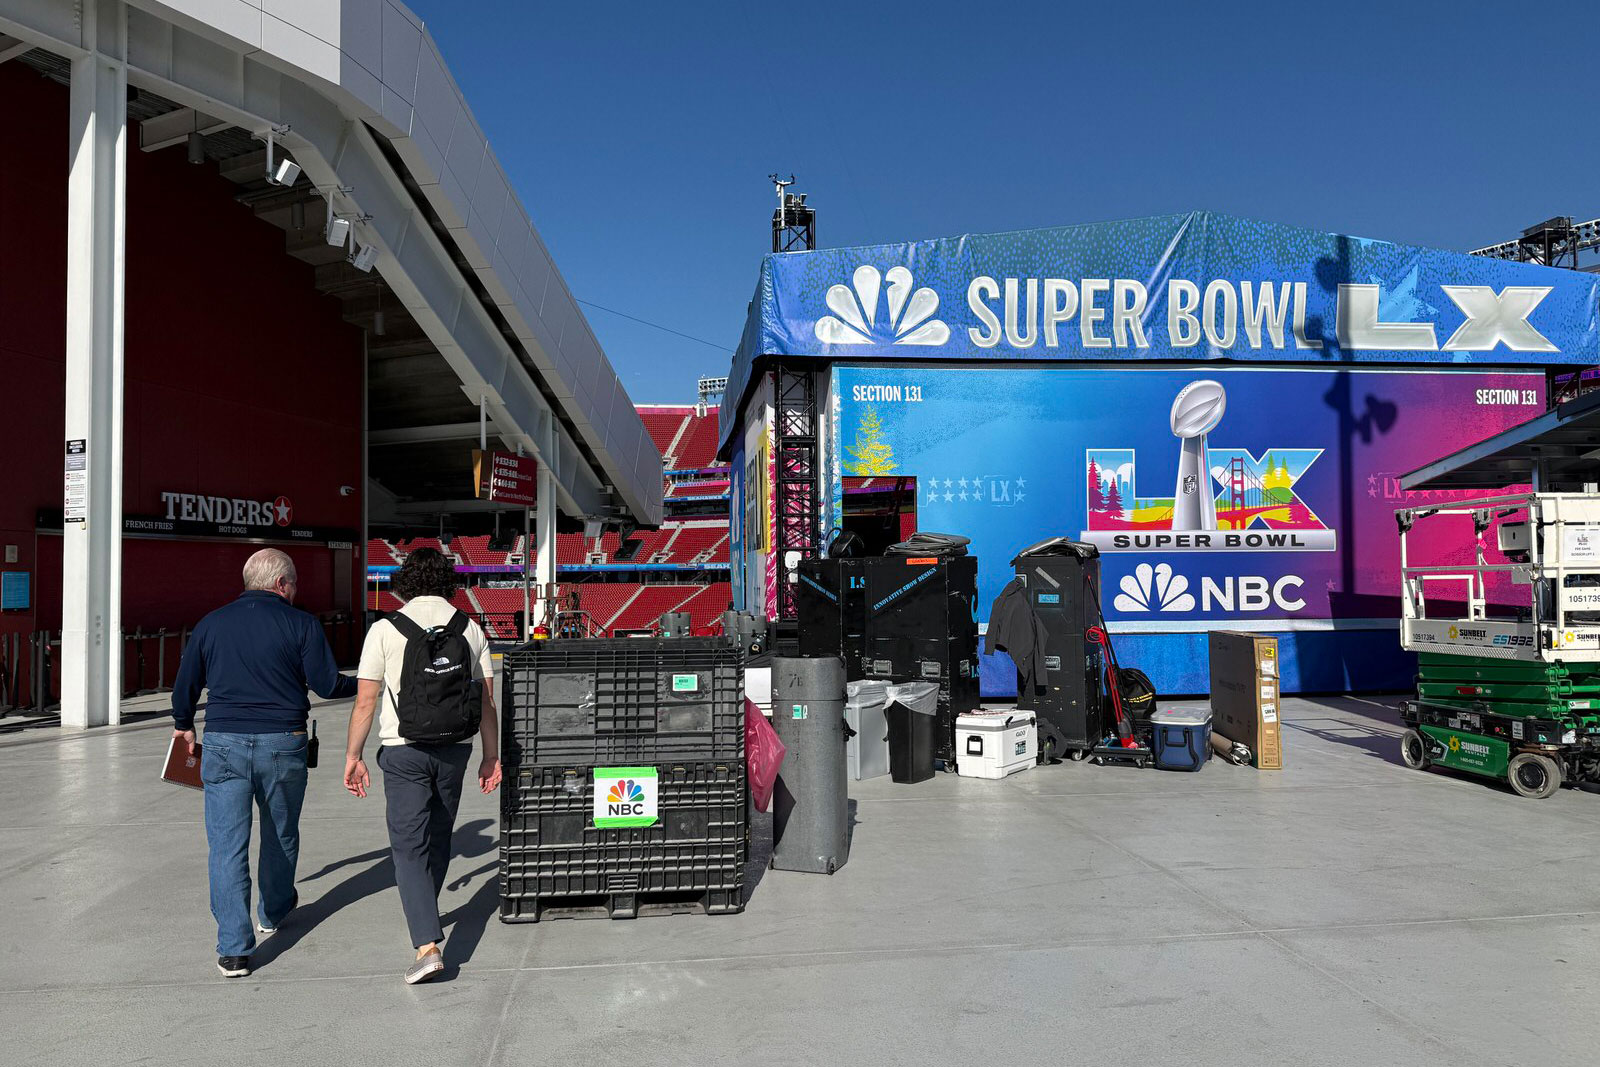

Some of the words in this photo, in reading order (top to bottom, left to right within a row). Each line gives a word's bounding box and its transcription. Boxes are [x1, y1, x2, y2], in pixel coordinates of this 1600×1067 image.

[967, 276, 1149, 349] SUPER
[1168, 279, 1323, 350] BOWL
[1335, 283, 1561, 352] LX
[853, 385, 902, 402] SECTION
[904, 385, 923, 402] 131
[1476, 388, 1519, 405] SECTION
[1521, 389, 1538, 406] 131
[991, 480, 1010, 502] LX
[1086, 448, 1329, 531] LX
[1383, 477, 1402, 499] LX
[161, 491, 274, 526] TENDERS
[125, 520, 154, 530] FRENCH
[154, 522, 174, 530] FRIES
[218, 525, 231, 533] HOT
[231, 526, 248, 534] DOGS
[1113, 534, 1212, 548] SUPER
[1225, 534, 1305, 548] BOWL
[873, 588, 904, 611] INNOVATIVE
[903, 579, 918, 592] SHOW
[917, 567, 937, 582] DESIGN
[1201, 575, 1306, 612] NBC
[1459, 629, 1487, 638] SUNBELT
[1492, 635, 1534, 645] ES1932
[1460, 741, 1490, 755] SUNBELT
[608, 804, 644, 816] NBC
